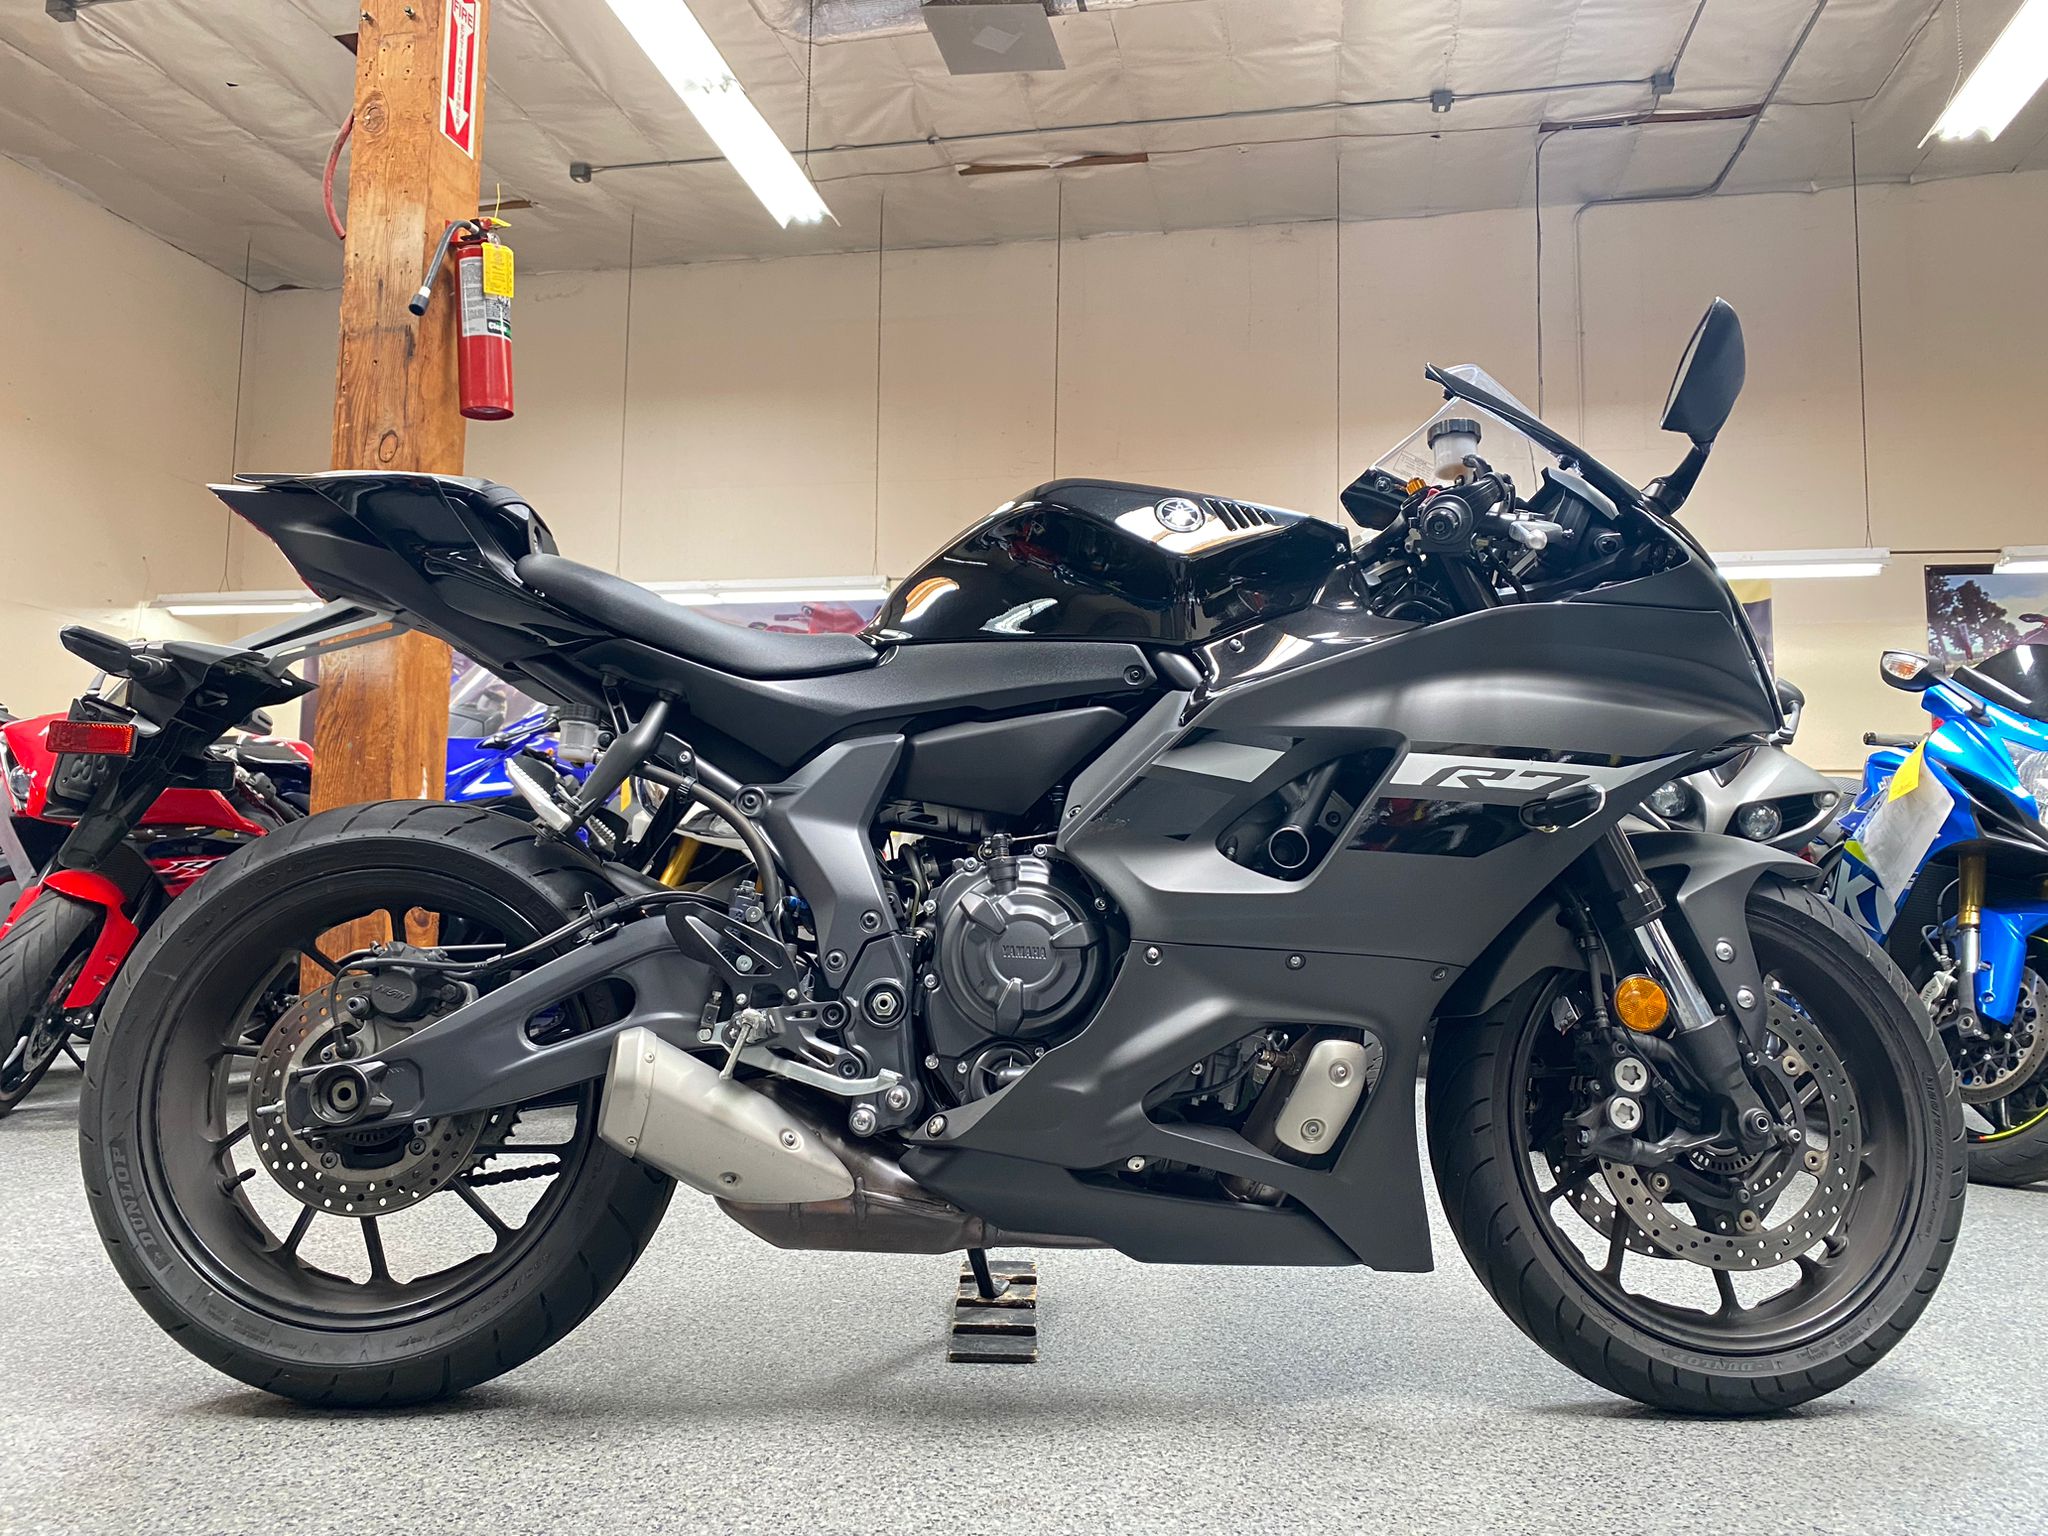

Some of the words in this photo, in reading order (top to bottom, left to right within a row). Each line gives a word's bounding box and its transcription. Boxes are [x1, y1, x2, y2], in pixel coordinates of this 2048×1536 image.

[452, 0, 473, 29] FIRE
[1421, 765, 1590, 794] R7
[1002, 944, 1046, 960] YAMAHA
[111, 1146, 157, 1248] DUNLOP
[1672, 1352, 1753, 1372] DUNLOP
